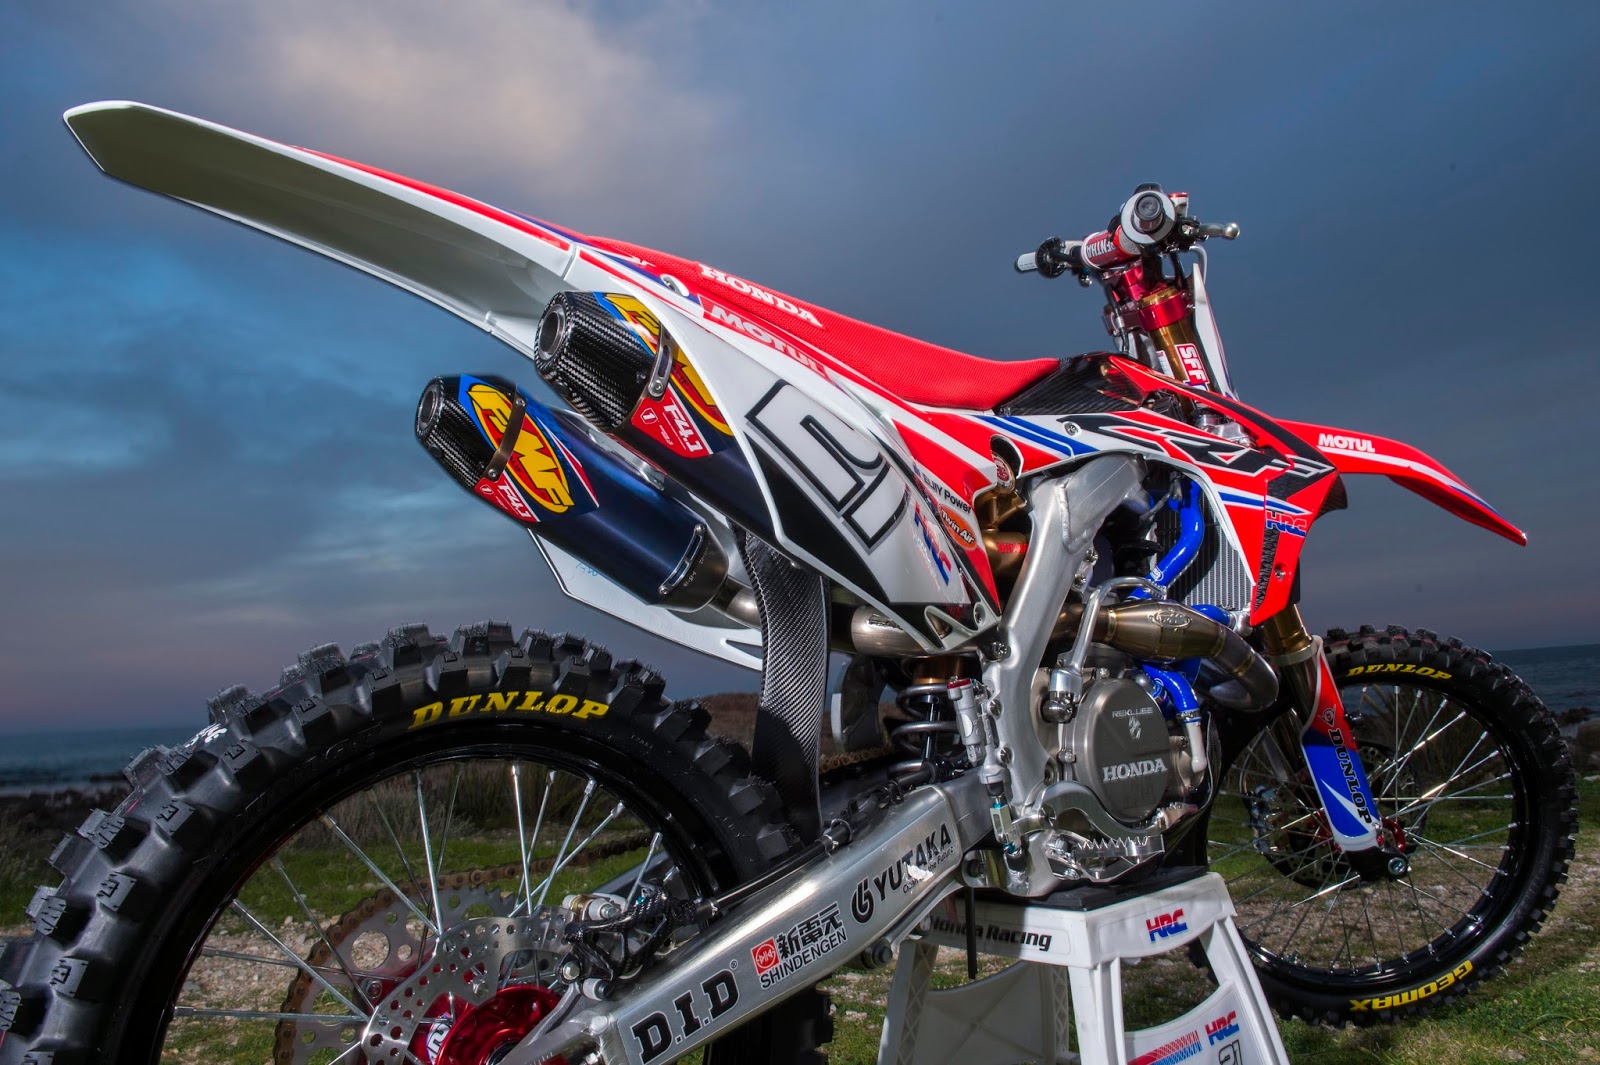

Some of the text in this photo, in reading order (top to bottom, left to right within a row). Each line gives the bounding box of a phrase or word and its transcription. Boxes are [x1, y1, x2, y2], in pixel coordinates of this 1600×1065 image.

[1086, 239, 1116, 258] RENTHA
[698, 263, 823, 327] HONDA
[711, 305, 826, 378] MOTUL
[1179, 346, 1207, 382] SFF
[664, 404, 704, 452] F4.1
[1318, 433, 1376, 453] MOTUL
[498, 483, 531, 518] F4.1
[944, 488, 972, 514] Power
[941, 508, 976, 545] Twin Air
[1265, 510, 1308, 539] HRC
[1346, 663, 1453, 680] DUNLOP
[408, 690, 610, 730] DUNLOP
[1102, 757, 1169, 782] HONDA
[1328, 727, 1373, 824] DUNLOP
[873, 822, 952, 902] YUTAKA
[986, 923, 1052, 952] Racing
[1146, 908, 1189, 942] HRC
[760, 927, 848, 990] SHINDENGEN
[1350, 960, 1473, 1012] GEOMAX
[1205, 1010, 1240, 1046] HRC
